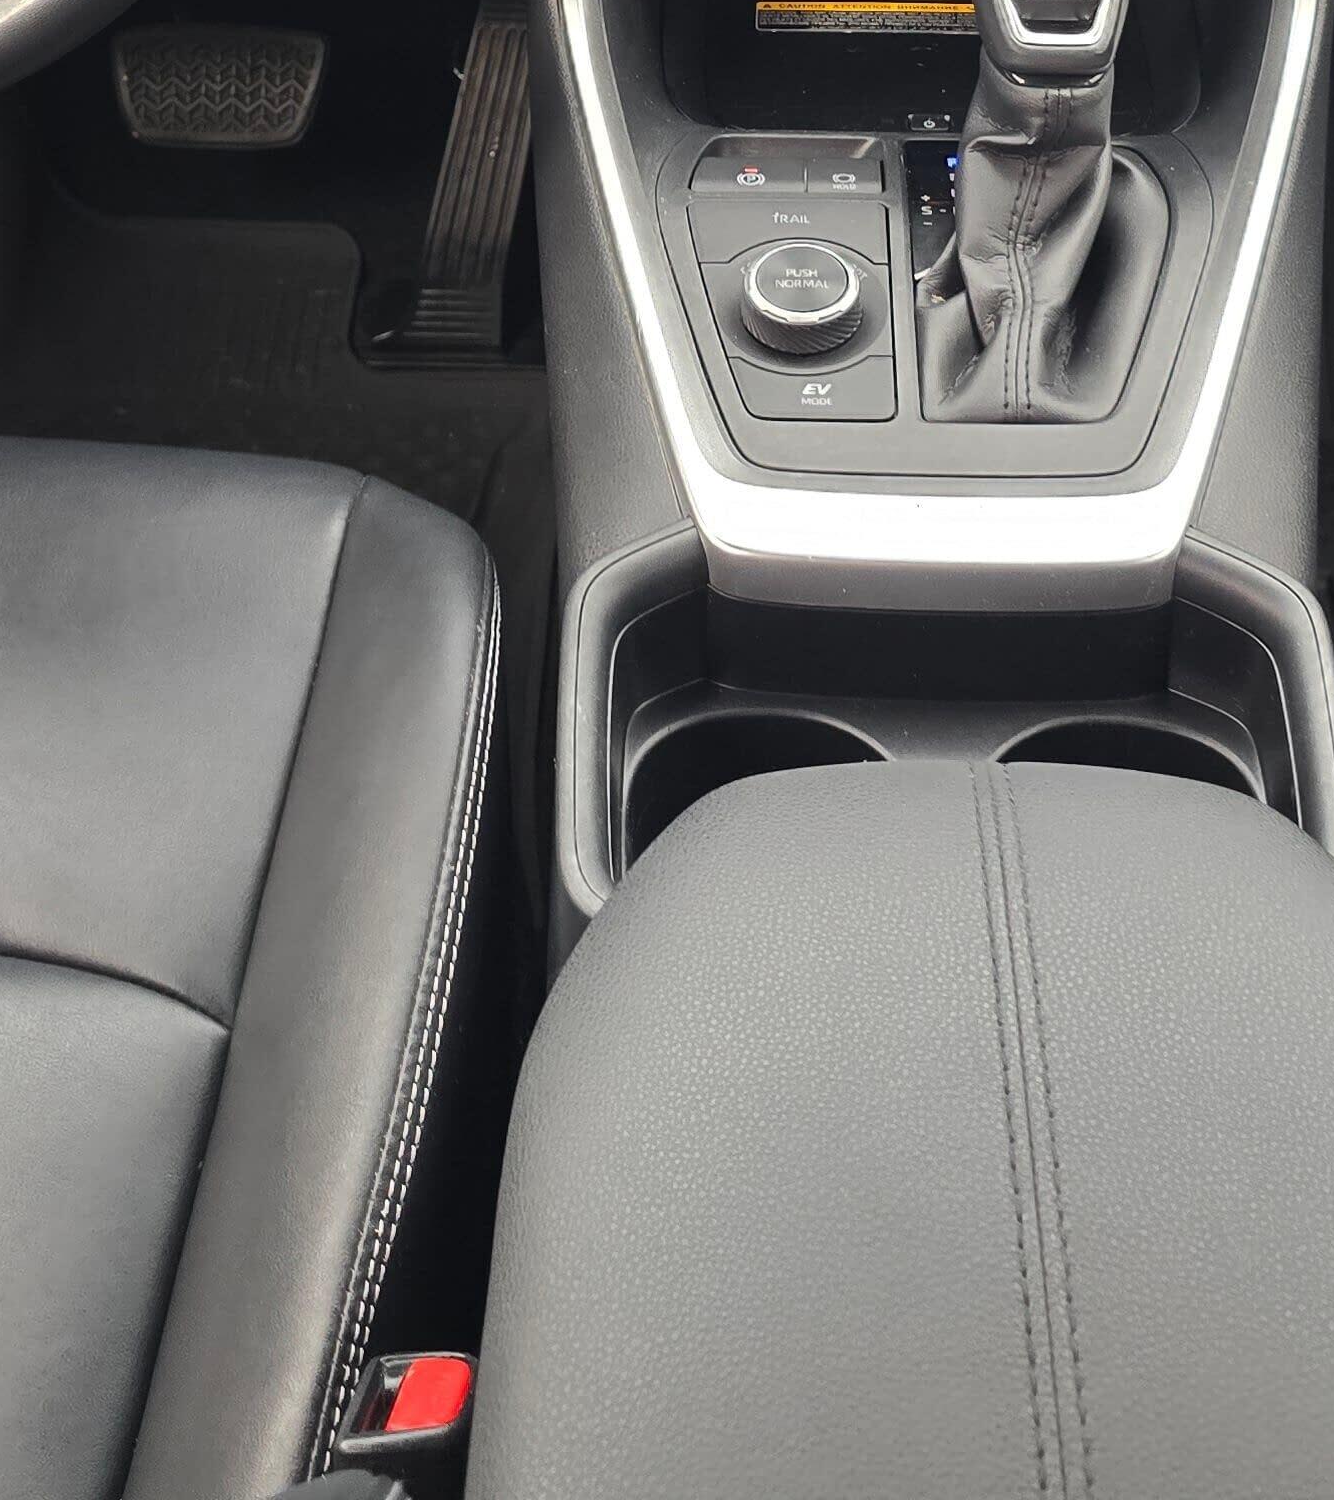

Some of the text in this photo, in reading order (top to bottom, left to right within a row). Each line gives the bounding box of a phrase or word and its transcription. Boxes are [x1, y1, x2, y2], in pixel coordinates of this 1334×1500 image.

[921, 205, 933, 216] S
[771, 211, 811, 224] TRAIL
[785, 268, 819, 278] PUSH
[774, 279, 830, 289] NORMAL
[802, 383, 833, 396] EV
[801, 397, 835, 406] MODE
